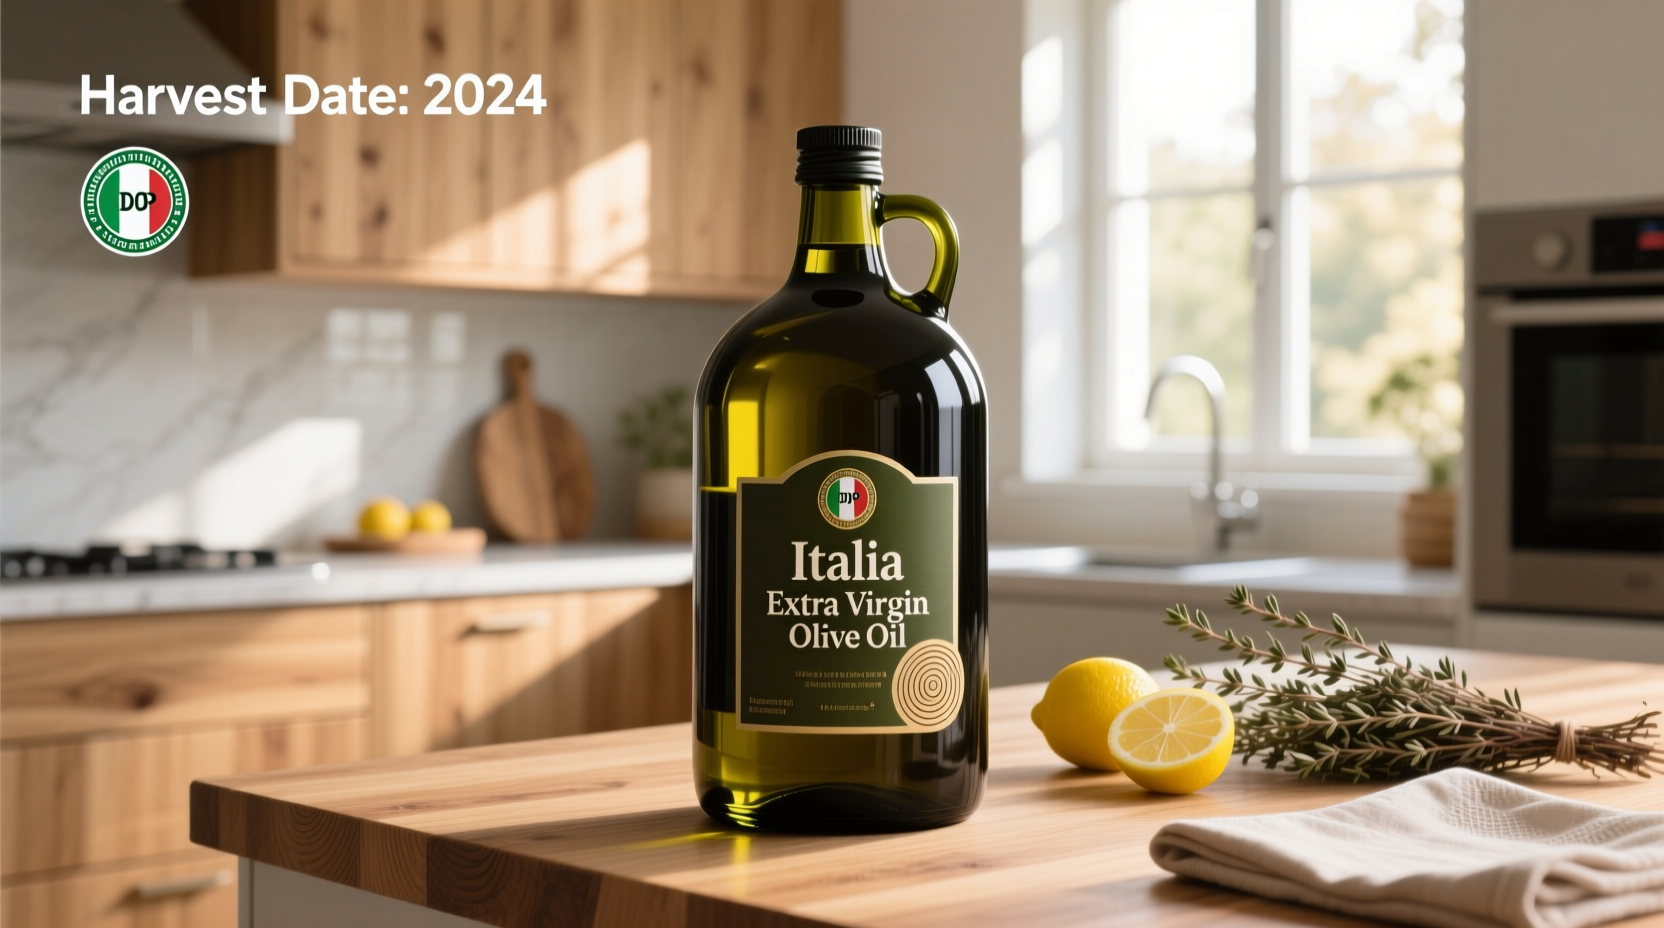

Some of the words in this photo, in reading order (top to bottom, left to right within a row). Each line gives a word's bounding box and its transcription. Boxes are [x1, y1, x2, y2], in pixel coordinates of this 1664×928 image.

[791, 539, 905, 581] Italia
[766, 590, 839, 617] Extra
[845, 589, 930, 623] Virgin
[789, 622, 860, 649] Olive
[866, 622, 907, 649] Oil
